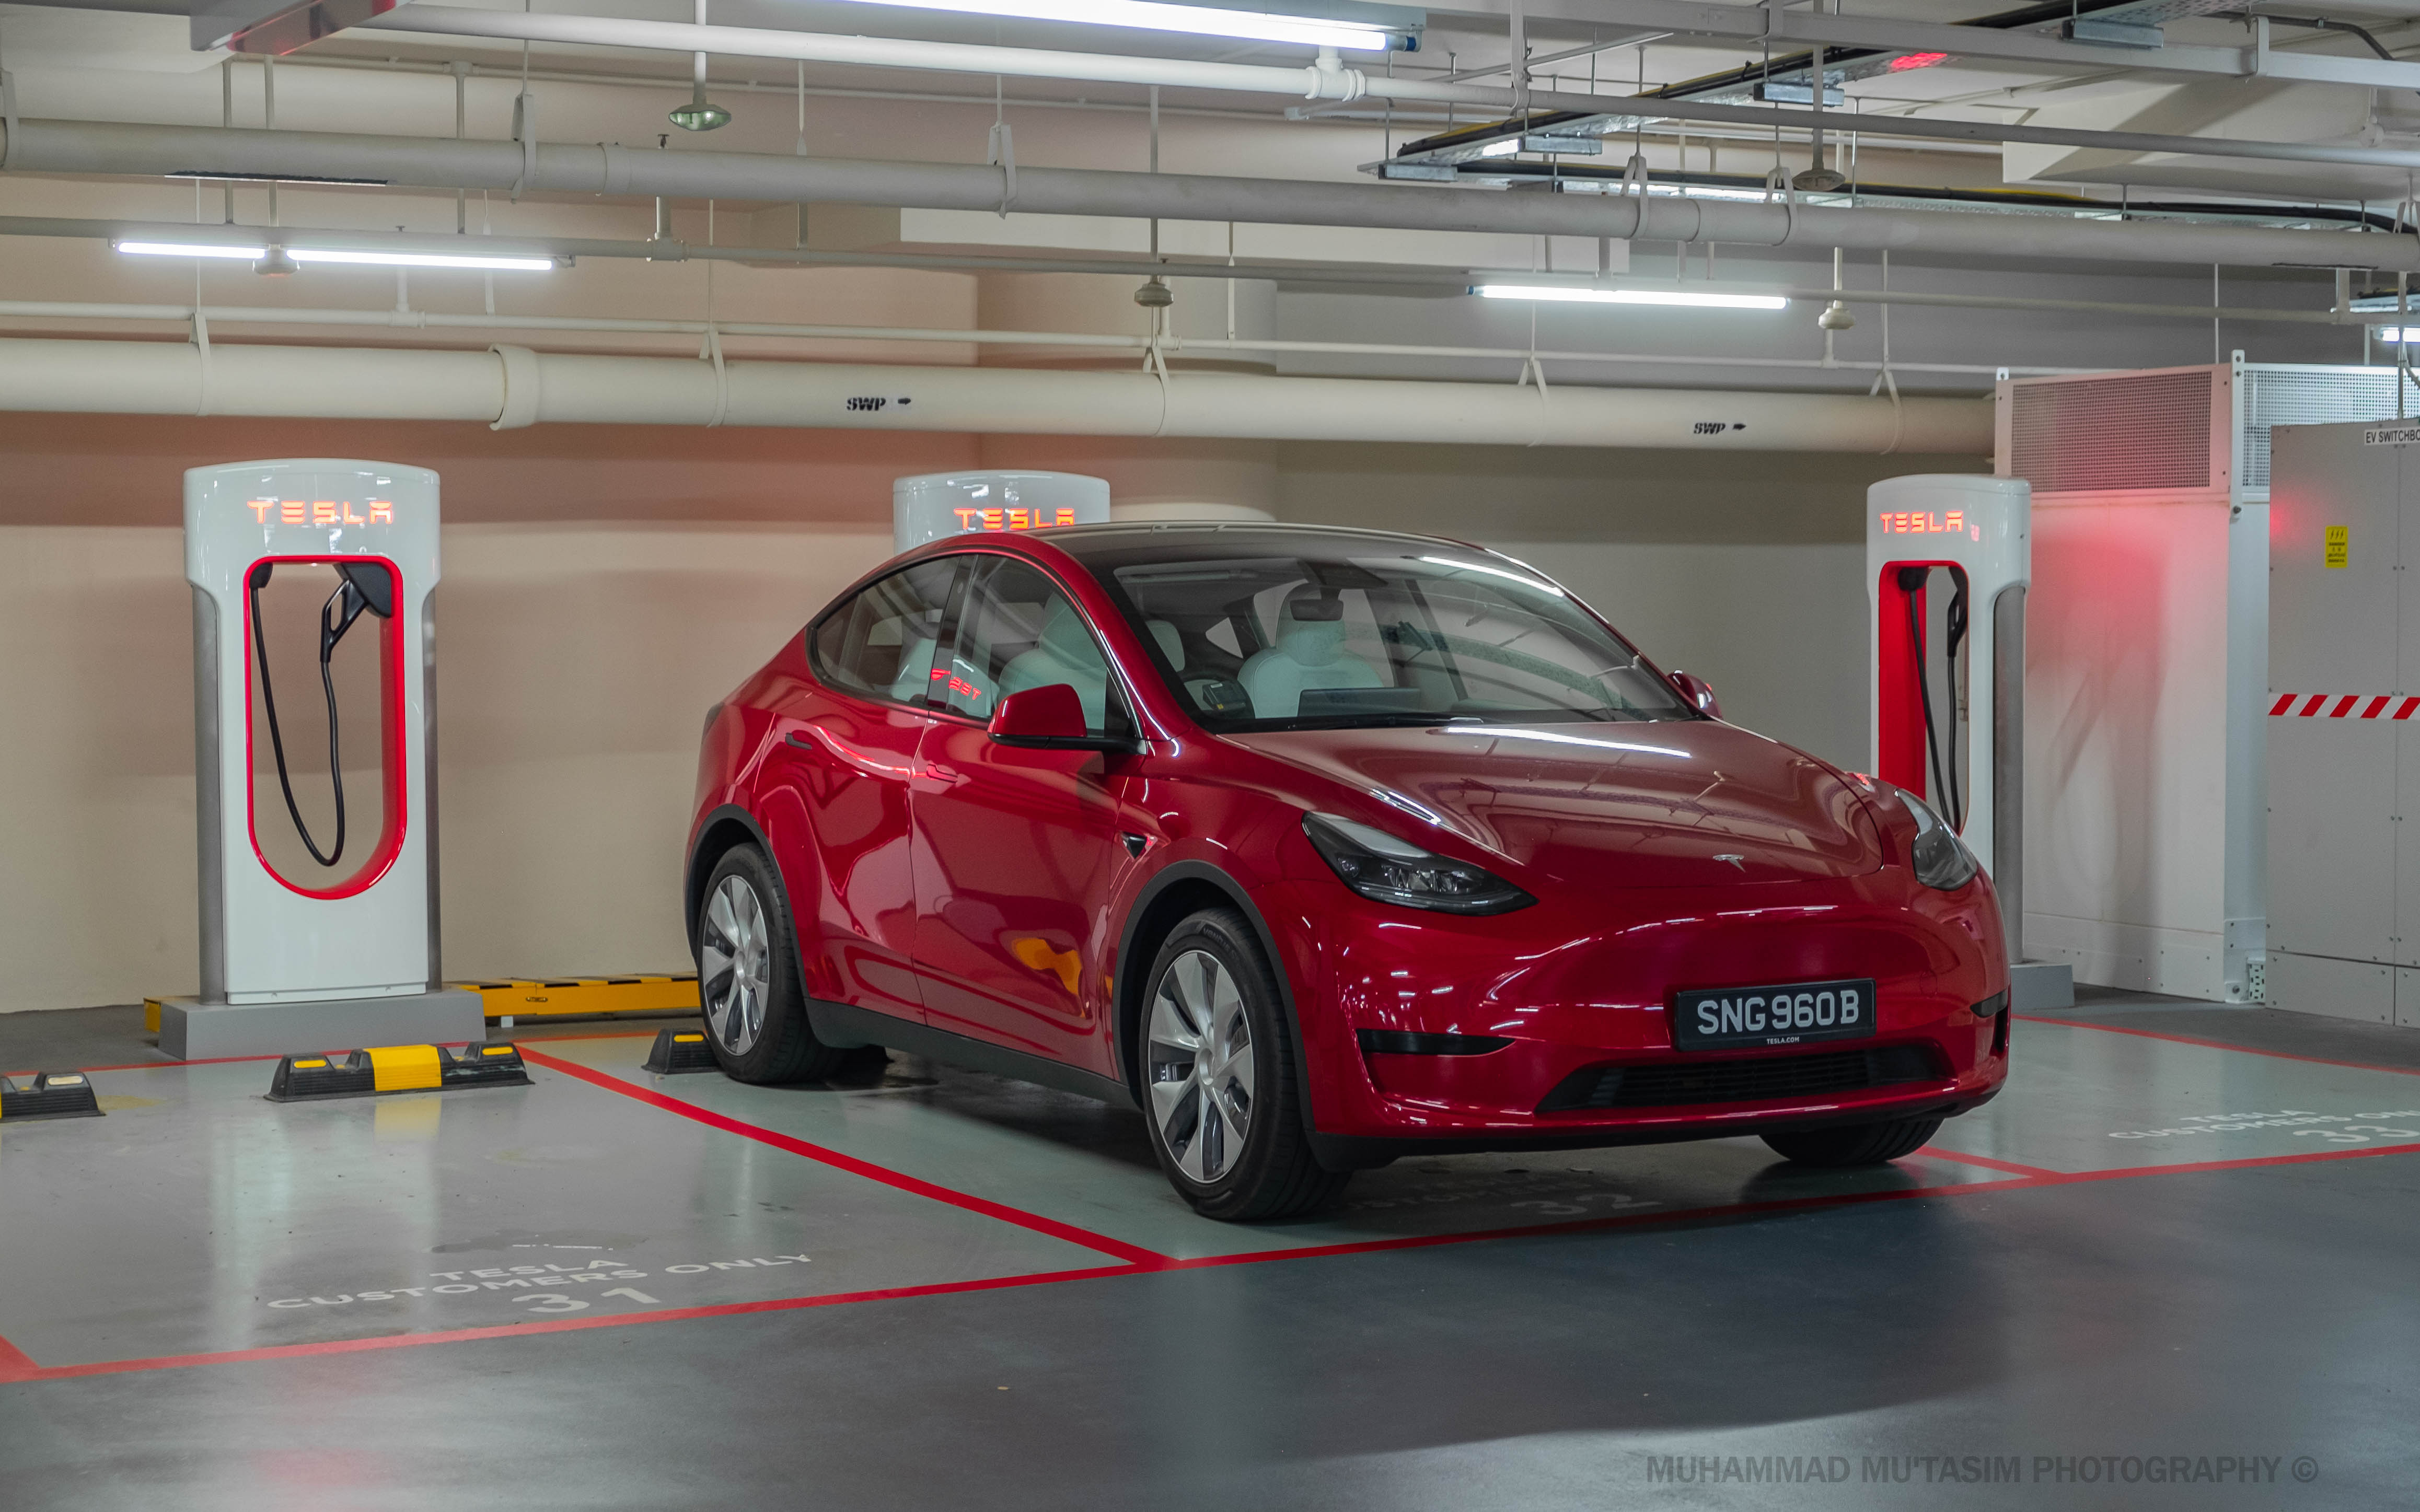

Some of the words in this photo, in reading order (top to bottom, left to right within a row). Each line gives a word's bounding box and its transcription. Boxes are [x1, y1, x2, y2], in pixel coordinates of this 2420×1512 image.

[847, 397, 886, 411] SWP
[1694, 422, 1726, 434] SWP
[2366, 432, 2376, 444] EV
[247, 501, 392, 524] TESLA
[954, 508, 1074, 530] TESLA
[1880, 510, 1963, 533] TESLA
[1698, 997, 1766, 1034] SNG
[1771, 992, 1835, 1029] 960
[1840, 989, 1859, 1025] B
[1767, 1036, 1799, 1045] TESLA.COM
[2109, 1115, 2352, 1138] CUSTOMERS
[2292, 1125, 2419, 1143] 33
[1510, 1193, 1663, 1215] 32
[267, 1270, 649, 1308] CUSTOMERS
[664, 1254, 812, 1274] ONLY
[430, 1260, 629, 1281] TESLA
[511, 1287, 662, 1312] 31
